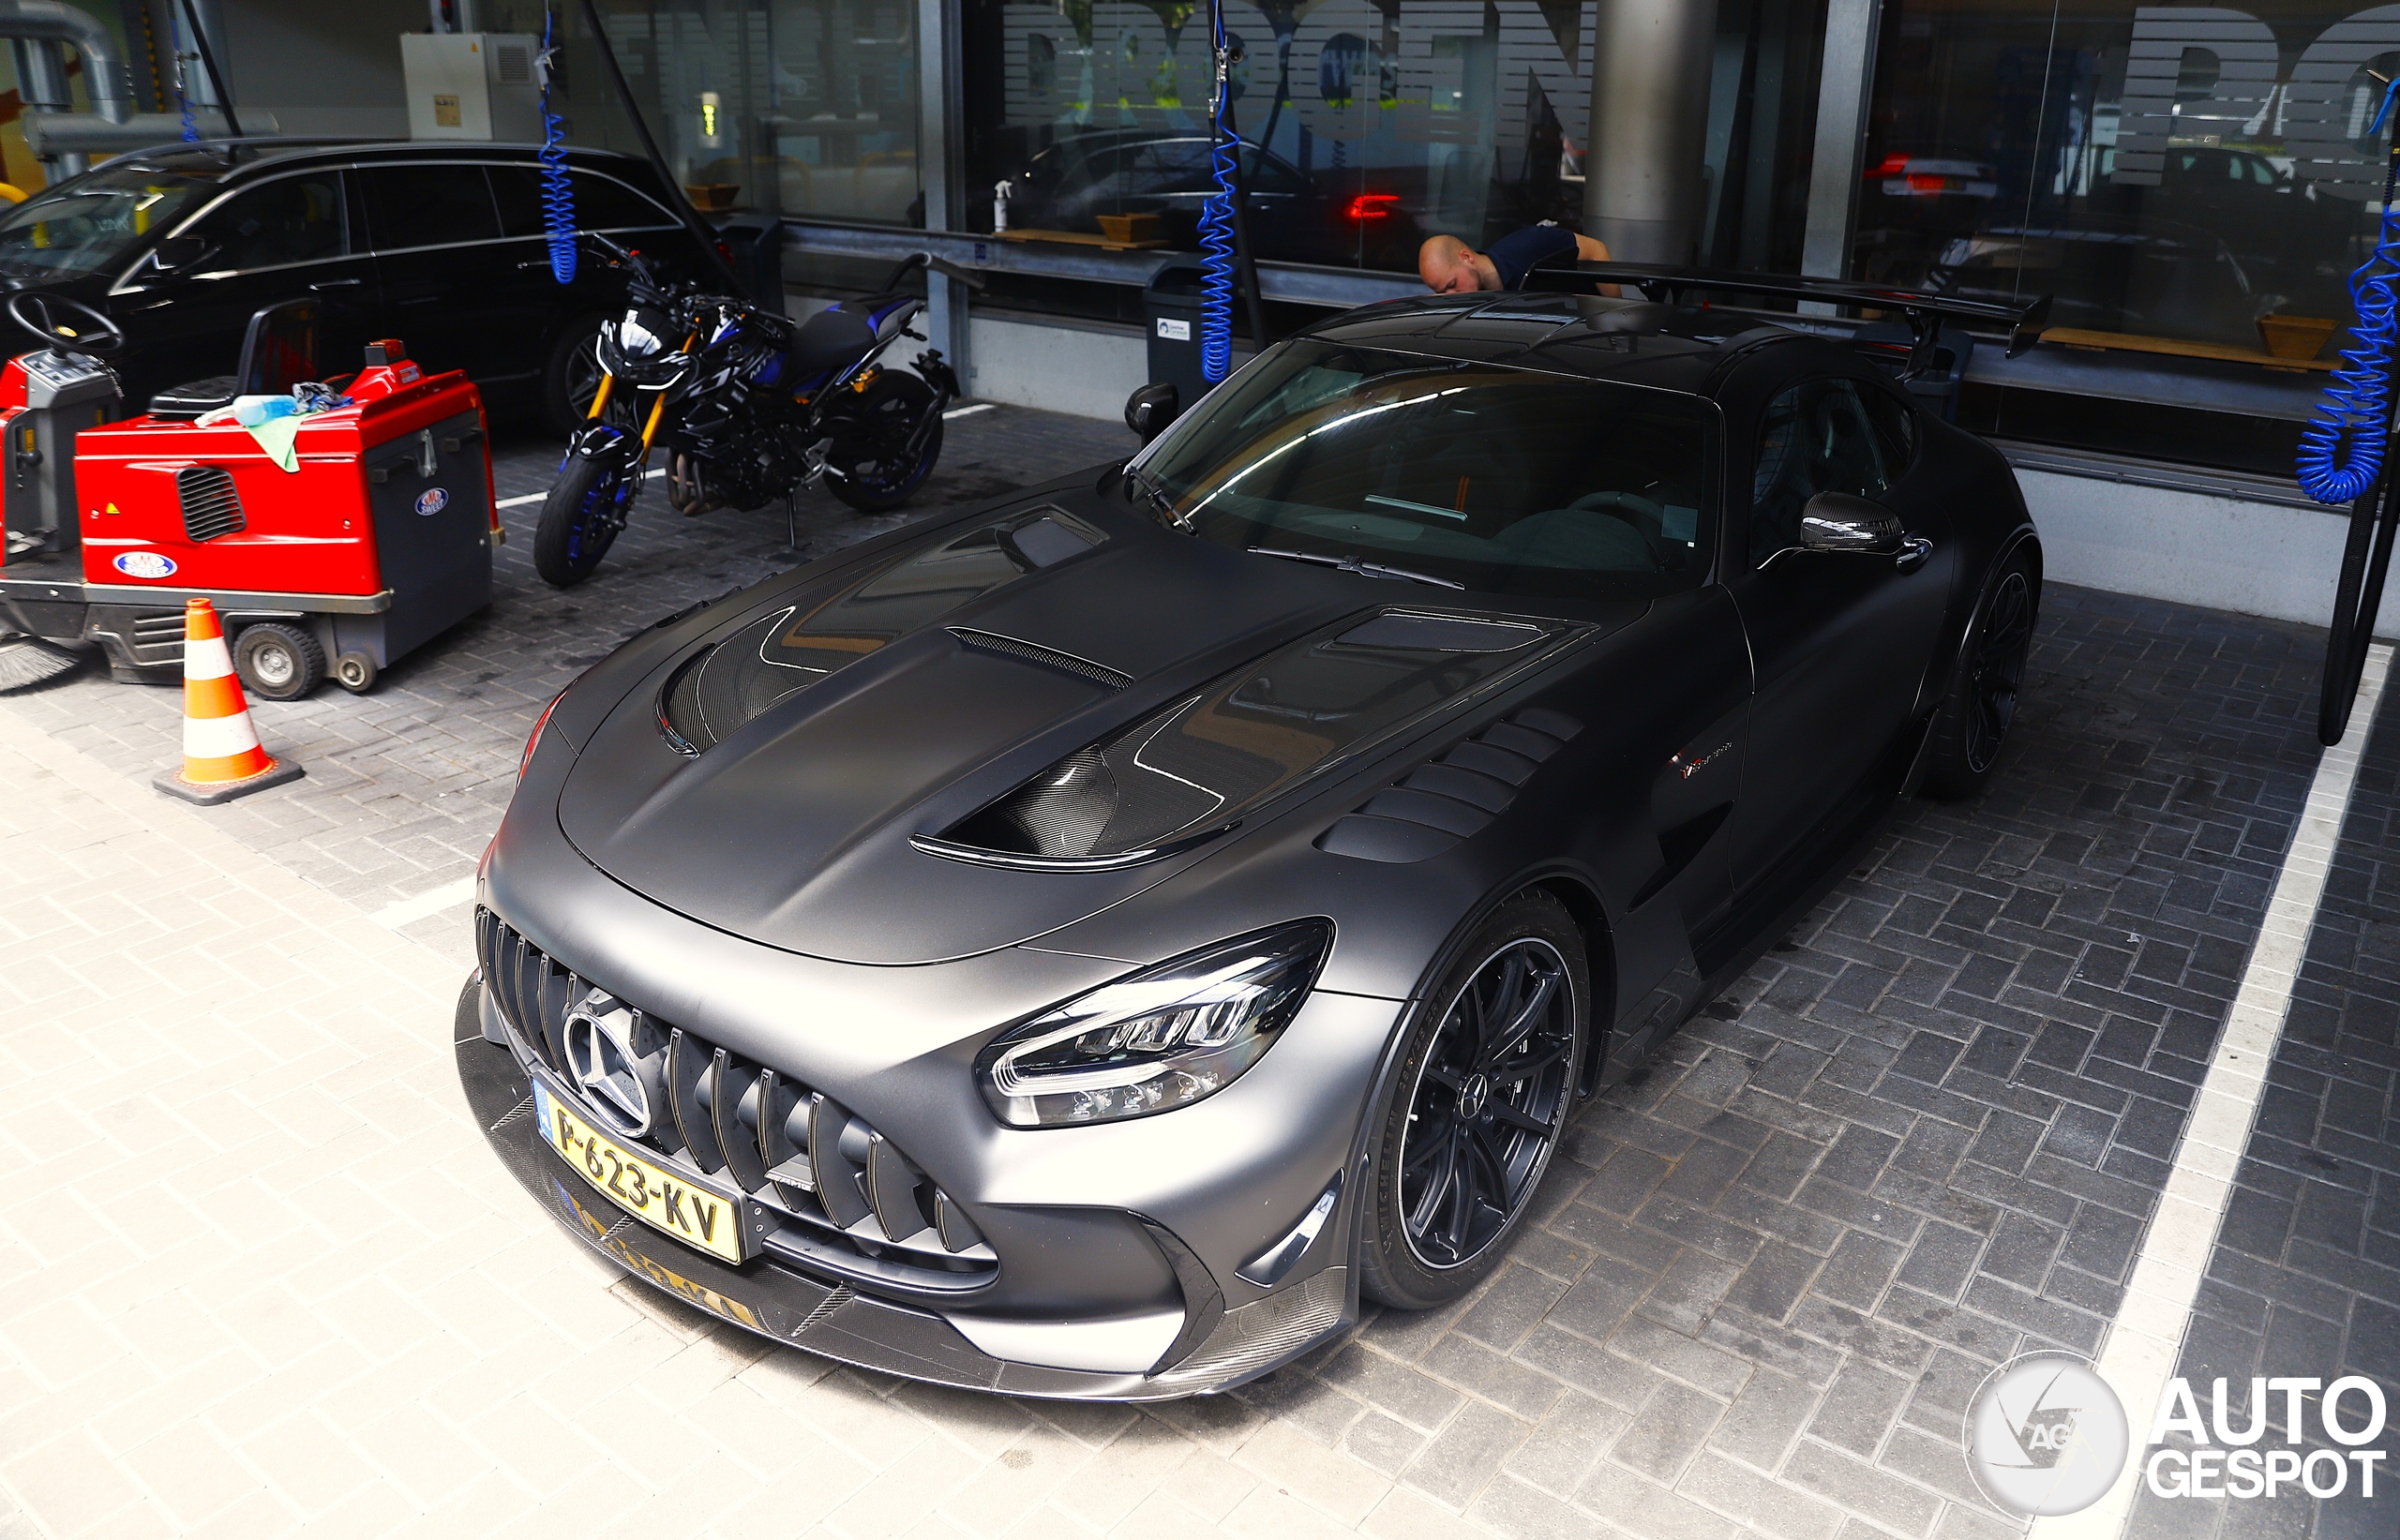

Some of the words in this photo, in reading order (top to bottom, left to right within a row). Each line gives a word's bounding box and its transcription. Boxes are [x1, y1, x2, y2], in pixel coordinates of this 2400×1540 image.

[556, 1108, 717, 1242] P-623-KV
[779, 1176, 813, 1192] AMG
[1378, 1109, 1399, 1233] MICHELIN
